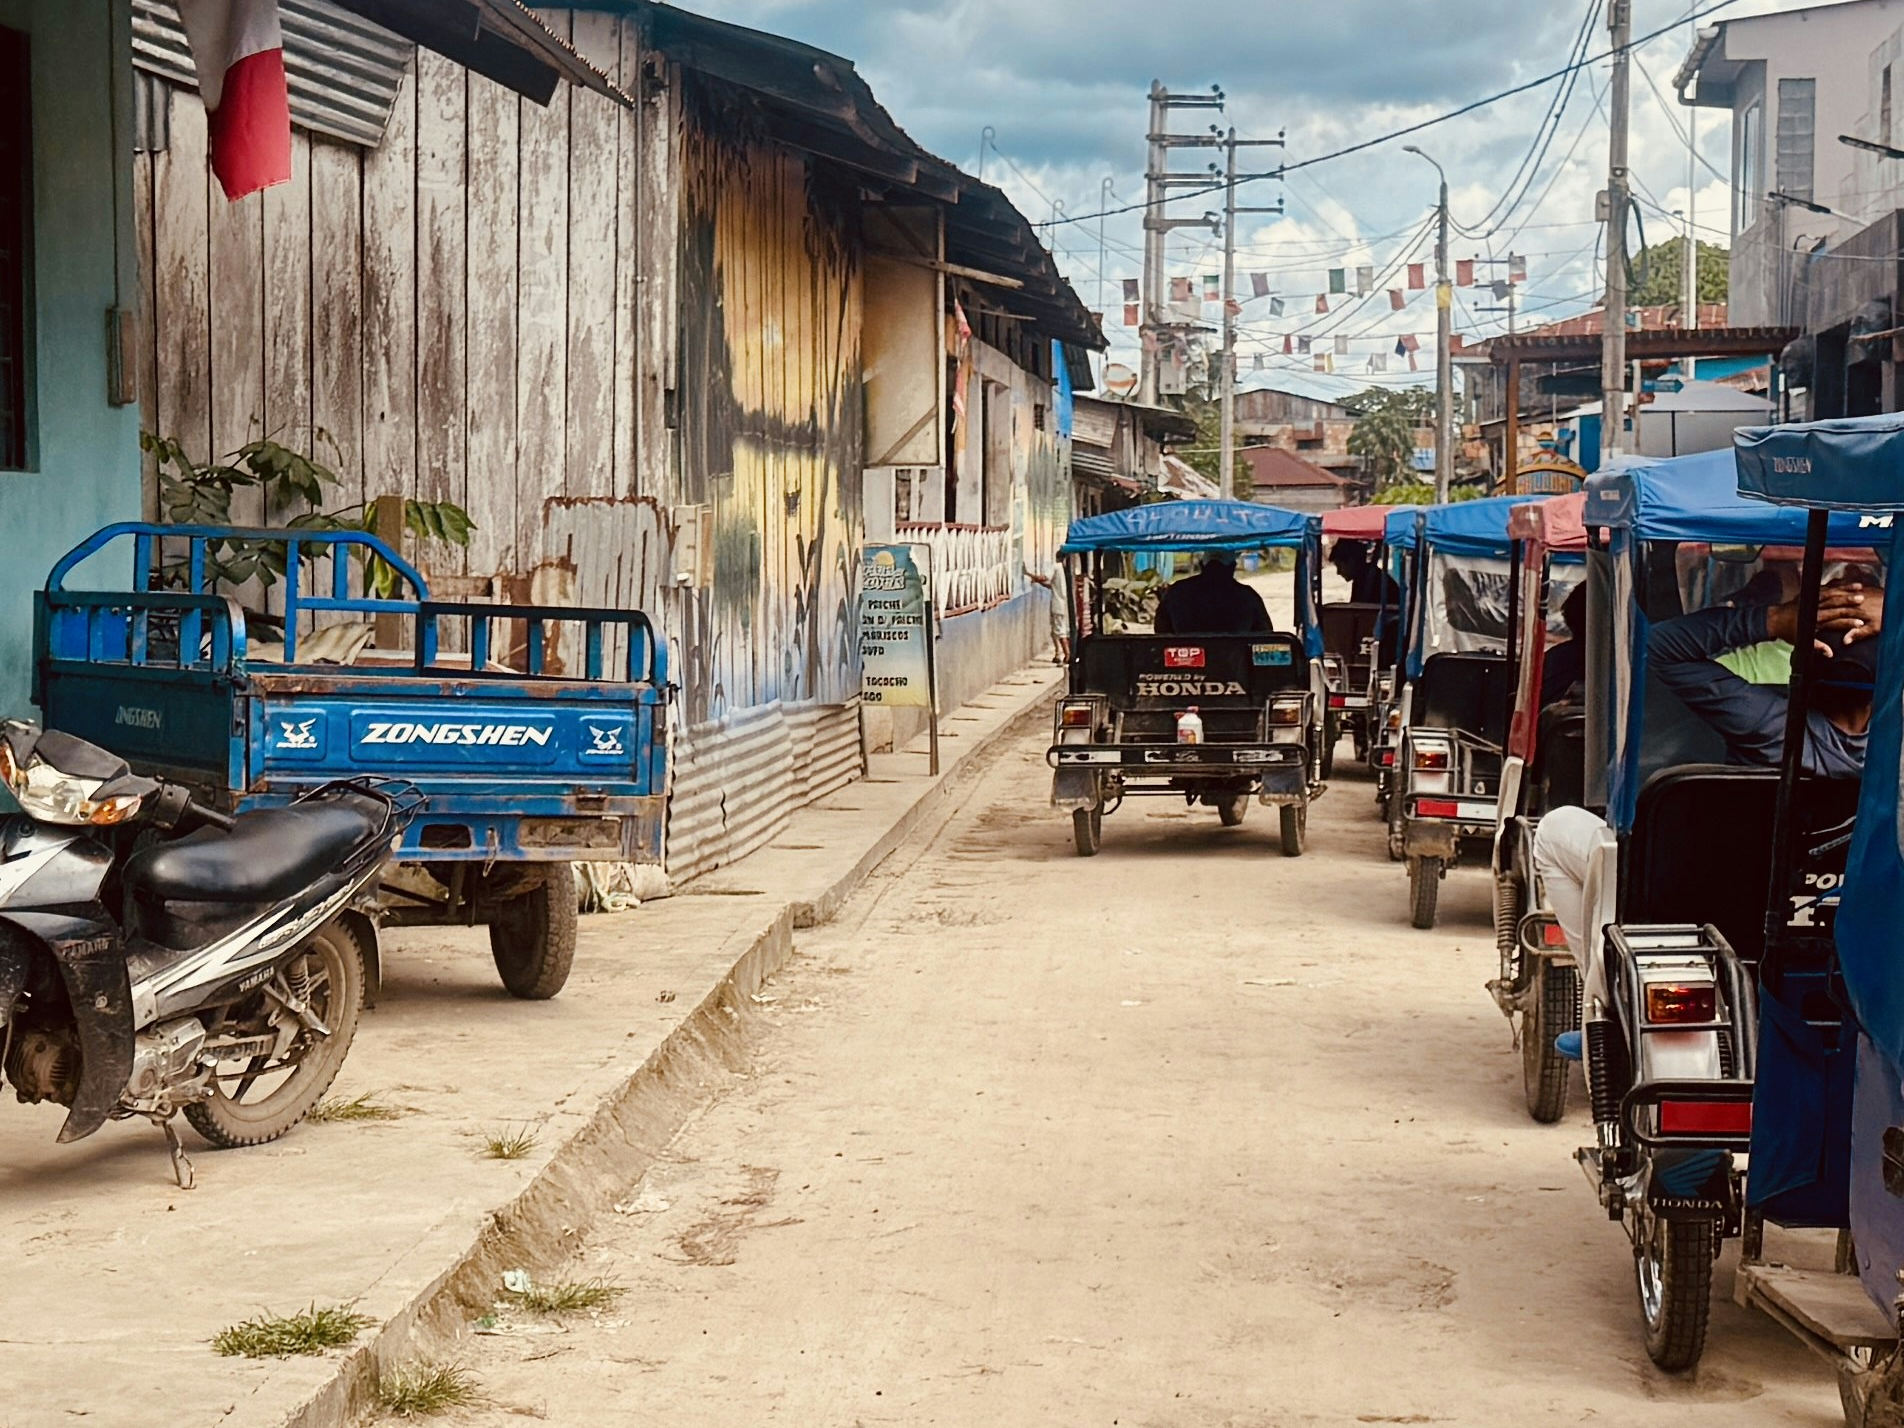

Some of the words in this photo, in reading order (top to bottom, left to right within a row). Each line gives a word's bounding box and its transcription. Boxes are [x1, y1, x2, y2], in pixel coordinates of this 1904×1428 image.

[1167, 647, 1201, 659] TOP
[1136, 682, 1247, 696] HONDA
[360, 723, 553, 746] ZONGSHEN
[1653, 1197, 1723, 1209] HONDA
